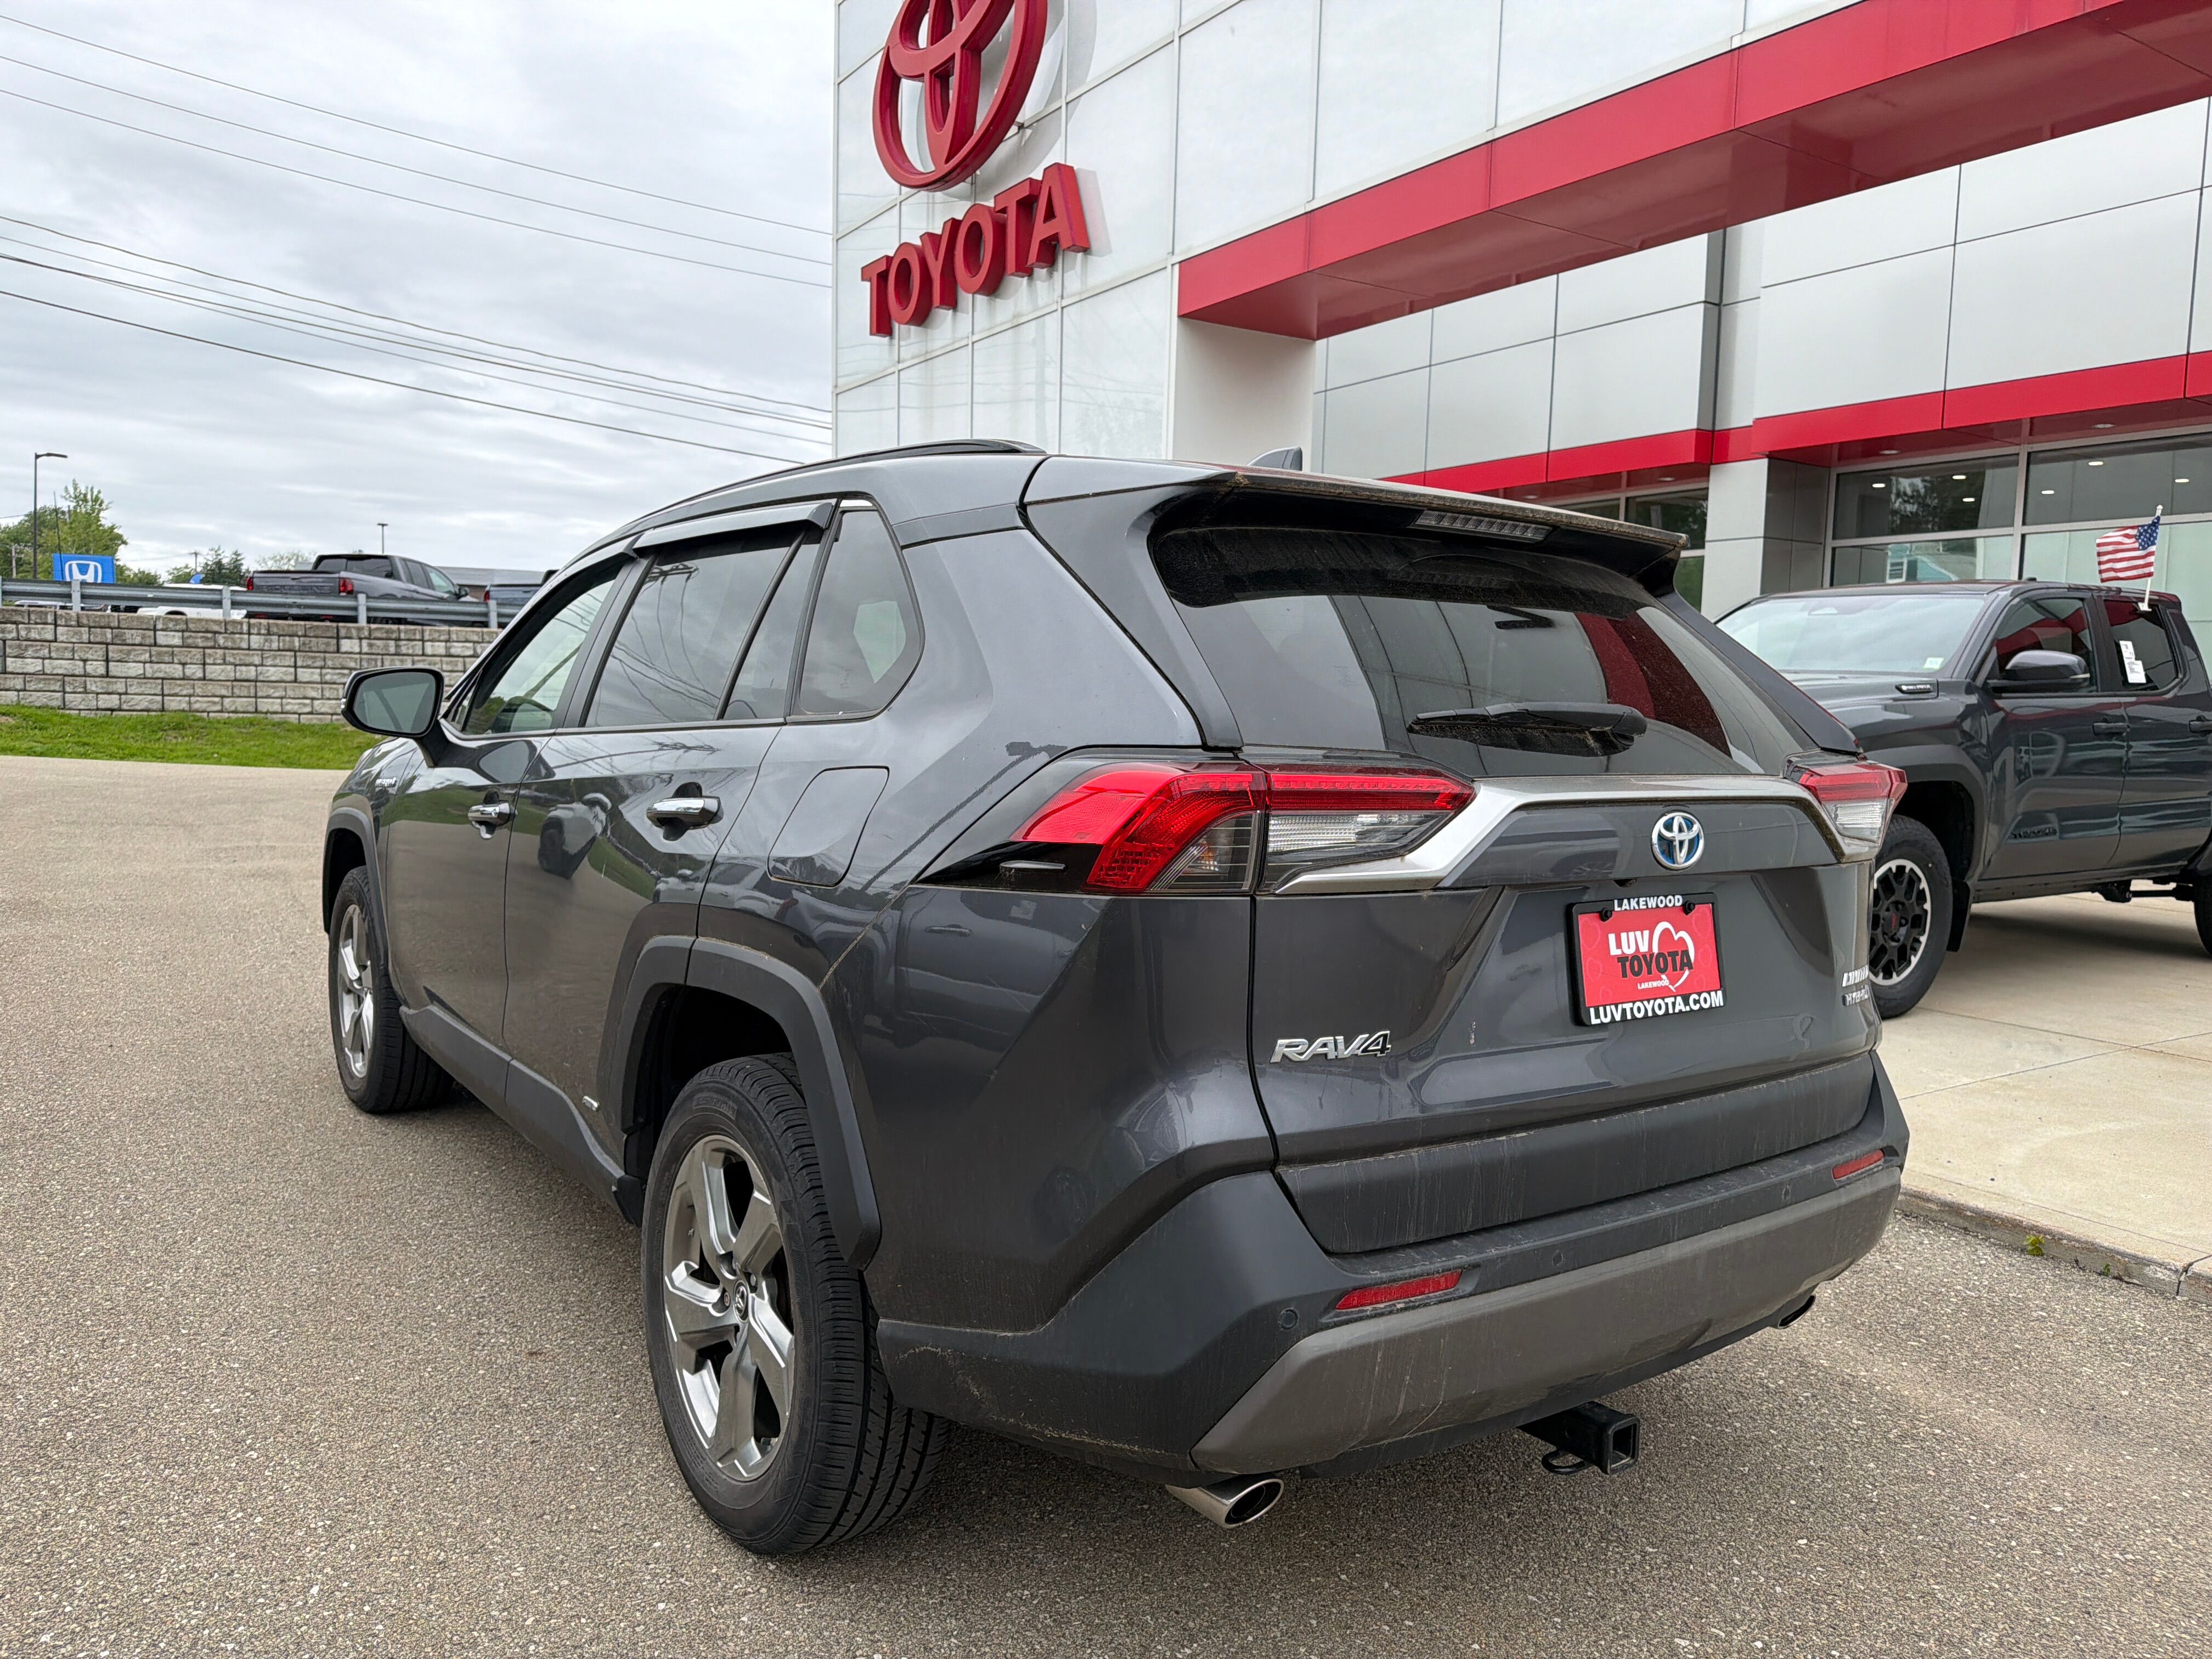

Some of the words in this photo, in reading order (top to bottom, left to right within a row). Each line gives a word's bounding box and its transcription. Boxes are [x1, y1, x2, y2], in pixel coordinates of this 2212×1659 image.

[861, 162, 1090, 337] TOYOTA
[1613, 895, 1683, 911] LAKEWOOD
[1608, 930, 1649, 956] LUV
[1617, 950, 1694, 978] TOYOTA
[1637, 979, 1669, 990] LAKEWOOD
[1589, 990, 1724, 1024] LUVTOYOTA.COM
[1269, 1030, 1392, 1063] RAV4
